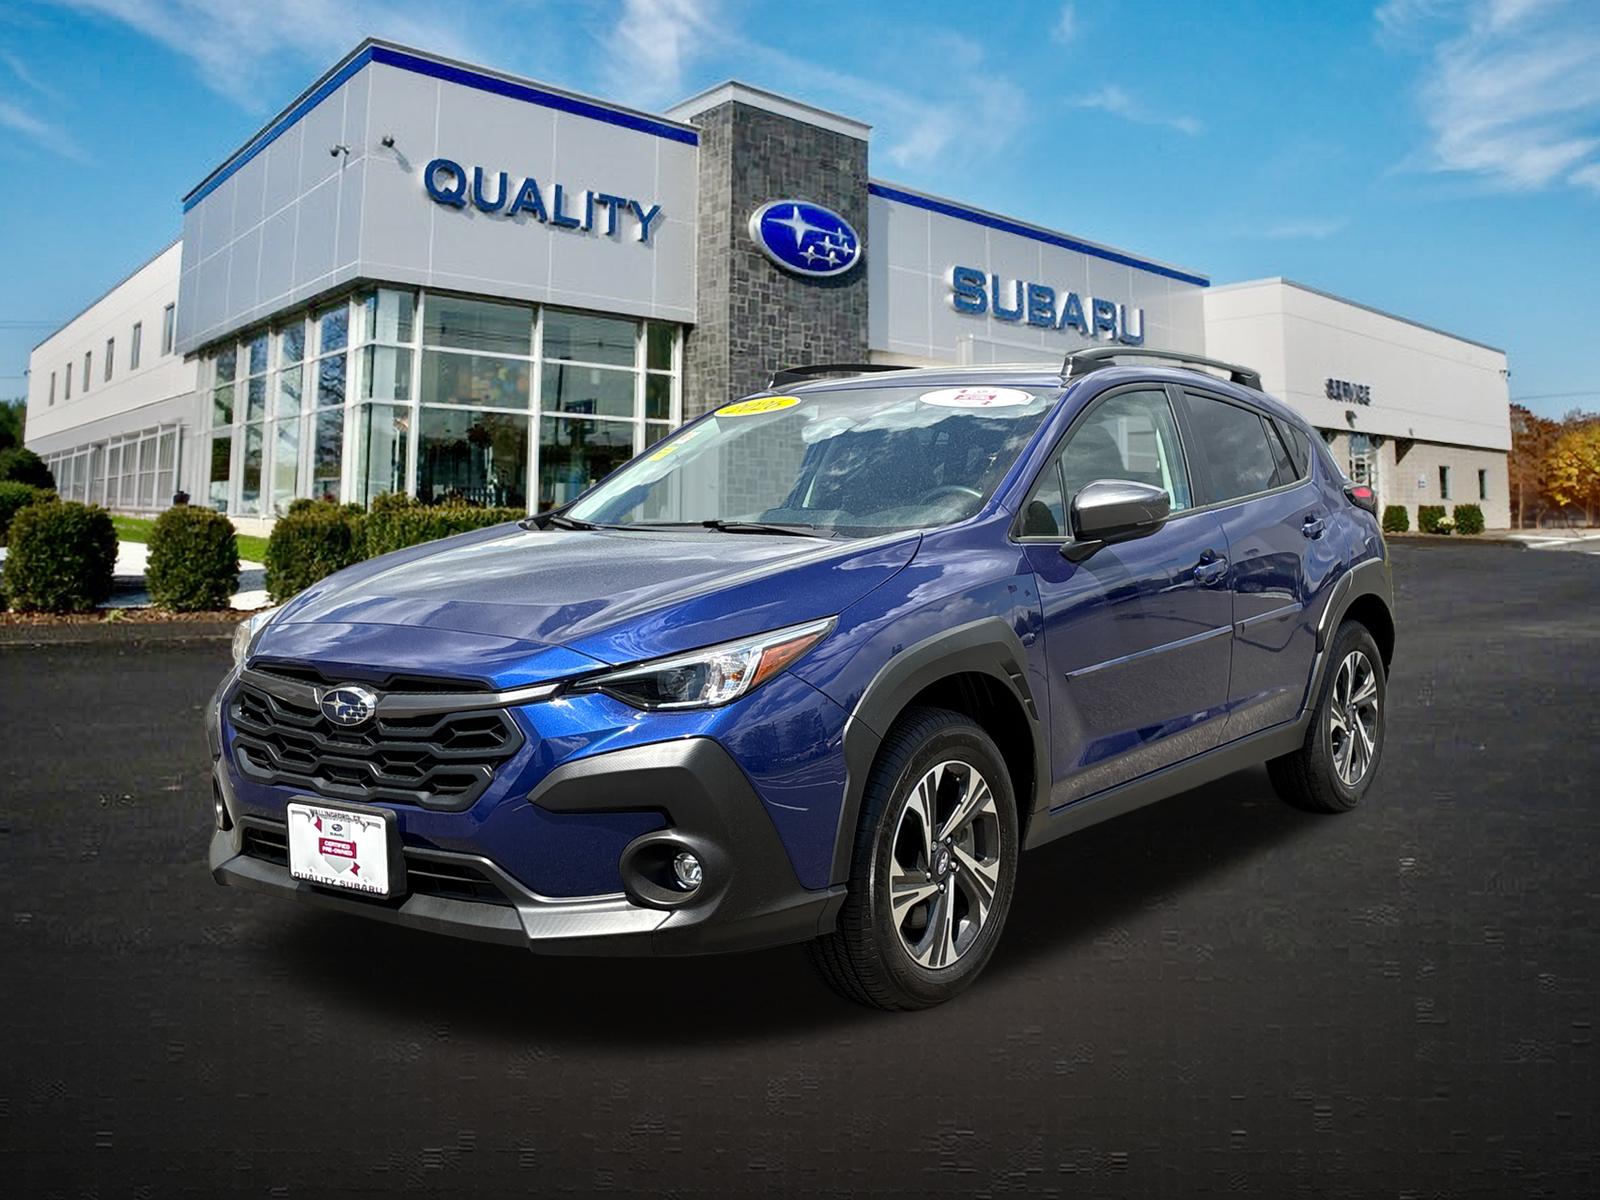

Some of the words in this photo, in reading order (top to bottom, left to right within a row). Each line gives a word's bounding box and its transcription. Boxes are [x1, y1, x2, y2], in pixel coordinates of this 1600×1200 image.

[424, 159, 661, 242] QUALITY
[950, 265, 1144, 345] SUBARU
[1325, 378, 1370, 406] SERVICE
[294, 871, 337, 885] QUALITY
[339, 880, 383, 894] SUBARU
